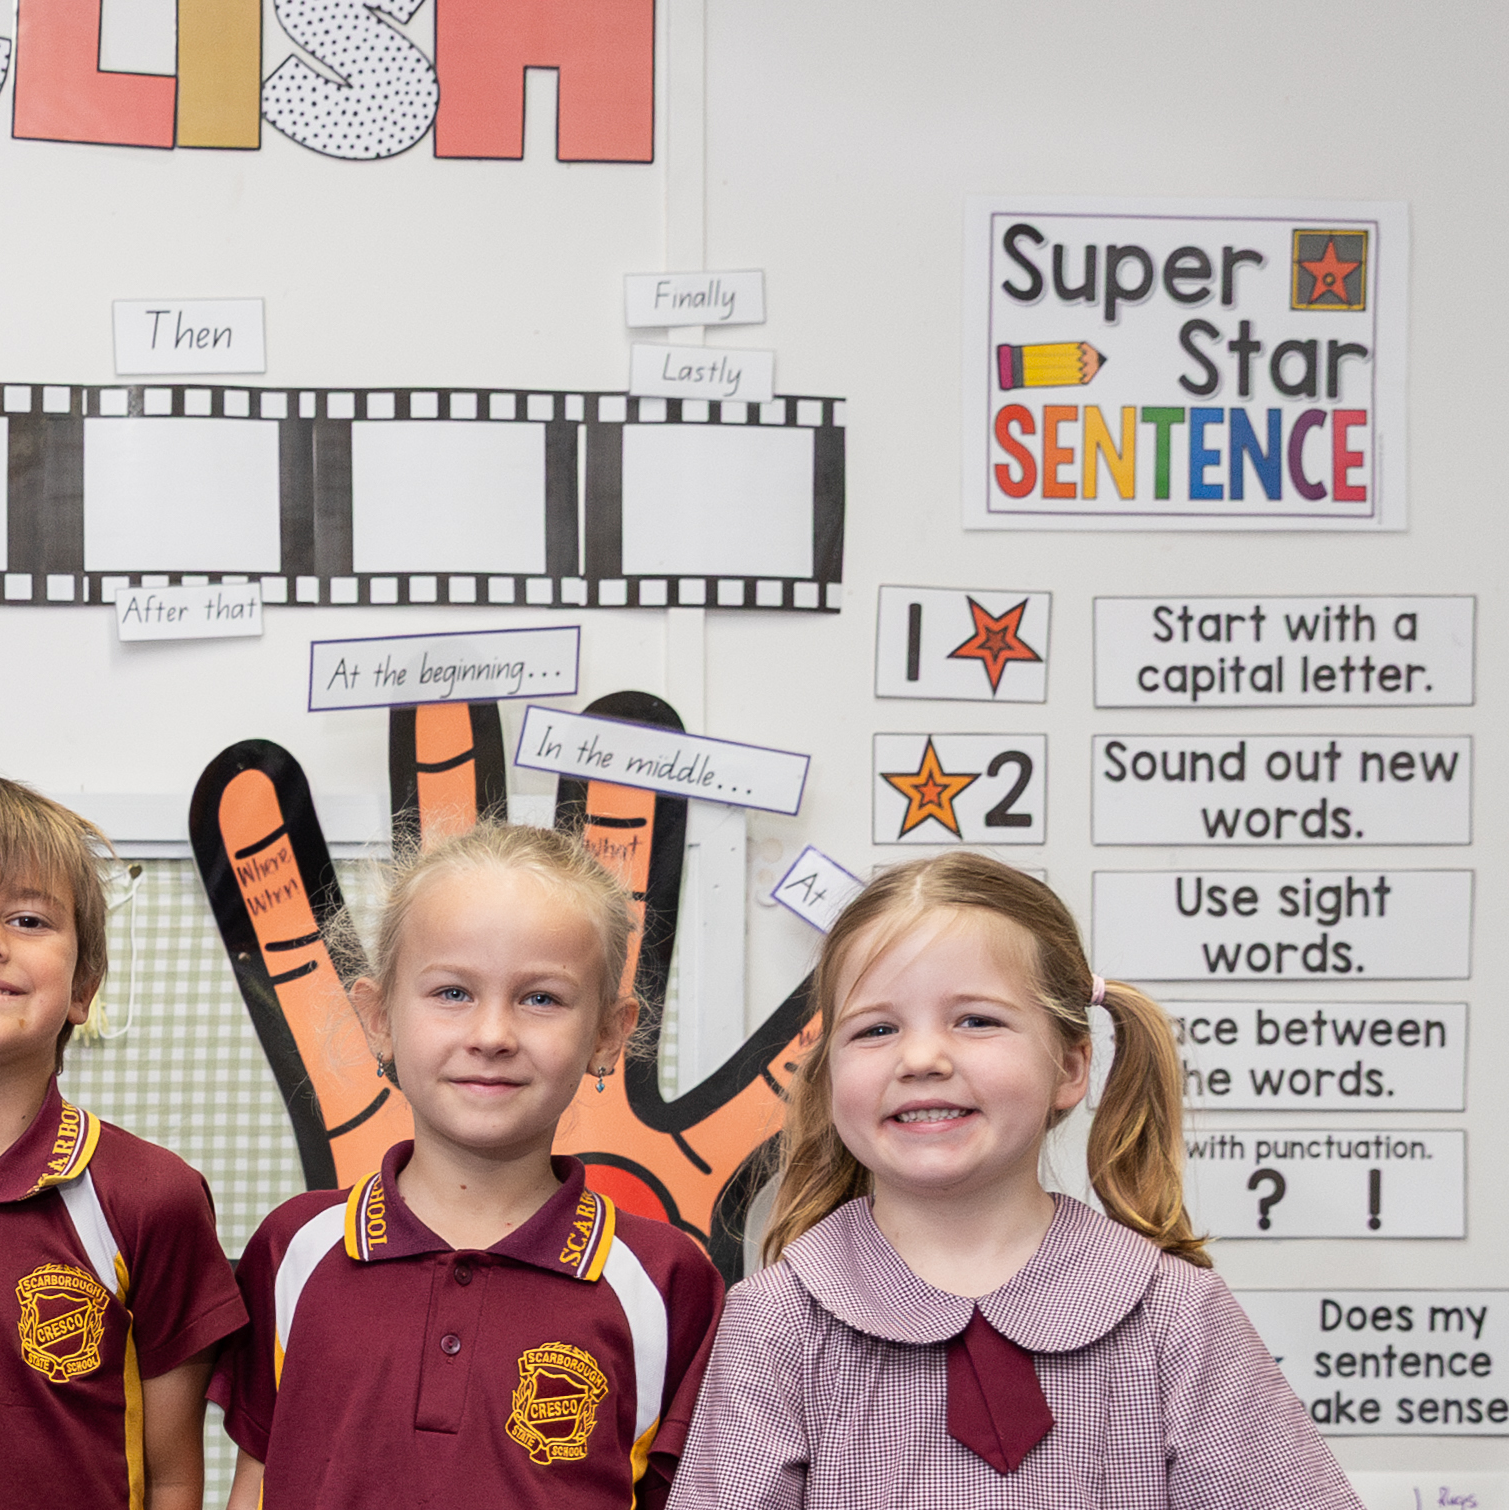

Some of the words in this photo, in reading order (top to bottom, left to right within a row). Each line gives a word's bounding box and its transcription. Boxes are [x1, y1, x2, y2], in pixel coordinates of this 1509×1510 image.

[1002, 223, 1265, 323] Super
[653, 281, 736, 320] Finally
[145, 310, 232, 352] Then
[661, 355, 741, 396] Lastly
[1178, 319, 1368, 399] Star
[994, 404, 1367, 502] SENTENCE
[122, 596, 188, 625] After
[204, 594, 259, 622] that
[1153, 605, 1266, 642] Start
[1285, 604, 1376, 642] with
[1394, 611, 1418, 642] a
[328, 658, 361, 691] At
[374, 657, 407, 686] the
[1137, 656, 1283, 702] capital
[1301, 656, 1433, 695] letter.
[535, 726, 562, 758] In
[577, 733, 614, 768] the
[1104, 741, 1247, 782] Sound
[1266, 741, 1341, 782] out
[1360, 747, 1460, 782] new
[984, 751, 1033, 828] 2
[1201, 798, 1364, 840] words.
[785, 868, 826, 907] At
[1175, 876, 1259, 918] Use
[1279, 875, 1391, 927] sight
[1202, 933, 1365, 974] words.
[1256, 1009, 1447, 1047] between
[1250, 1060, 1395, 1097] words.
[1256, 1136, 1433, 1164] punctuation.
[22, 1271, 102, 1296] SCARBOROUGH
[36, 1314, 83, 1343] CRESCO
[1320, 1299, 1413, 1332] Does
[1429, 1306, 1487, 1340] my
[28, 1351, 50, 1370] STATE
[66, 1355, 99, 1374] SCHOOL
[527, 1352, 605, 1387] SCARBOROUGH
[1315, 1345, 1492, 1378] sentence
[530, 1399, 578, 1418] CRESCO
[511, 1424, 537, 1448] STATE
[551, 1444, 585, 1458] SCHOOL
